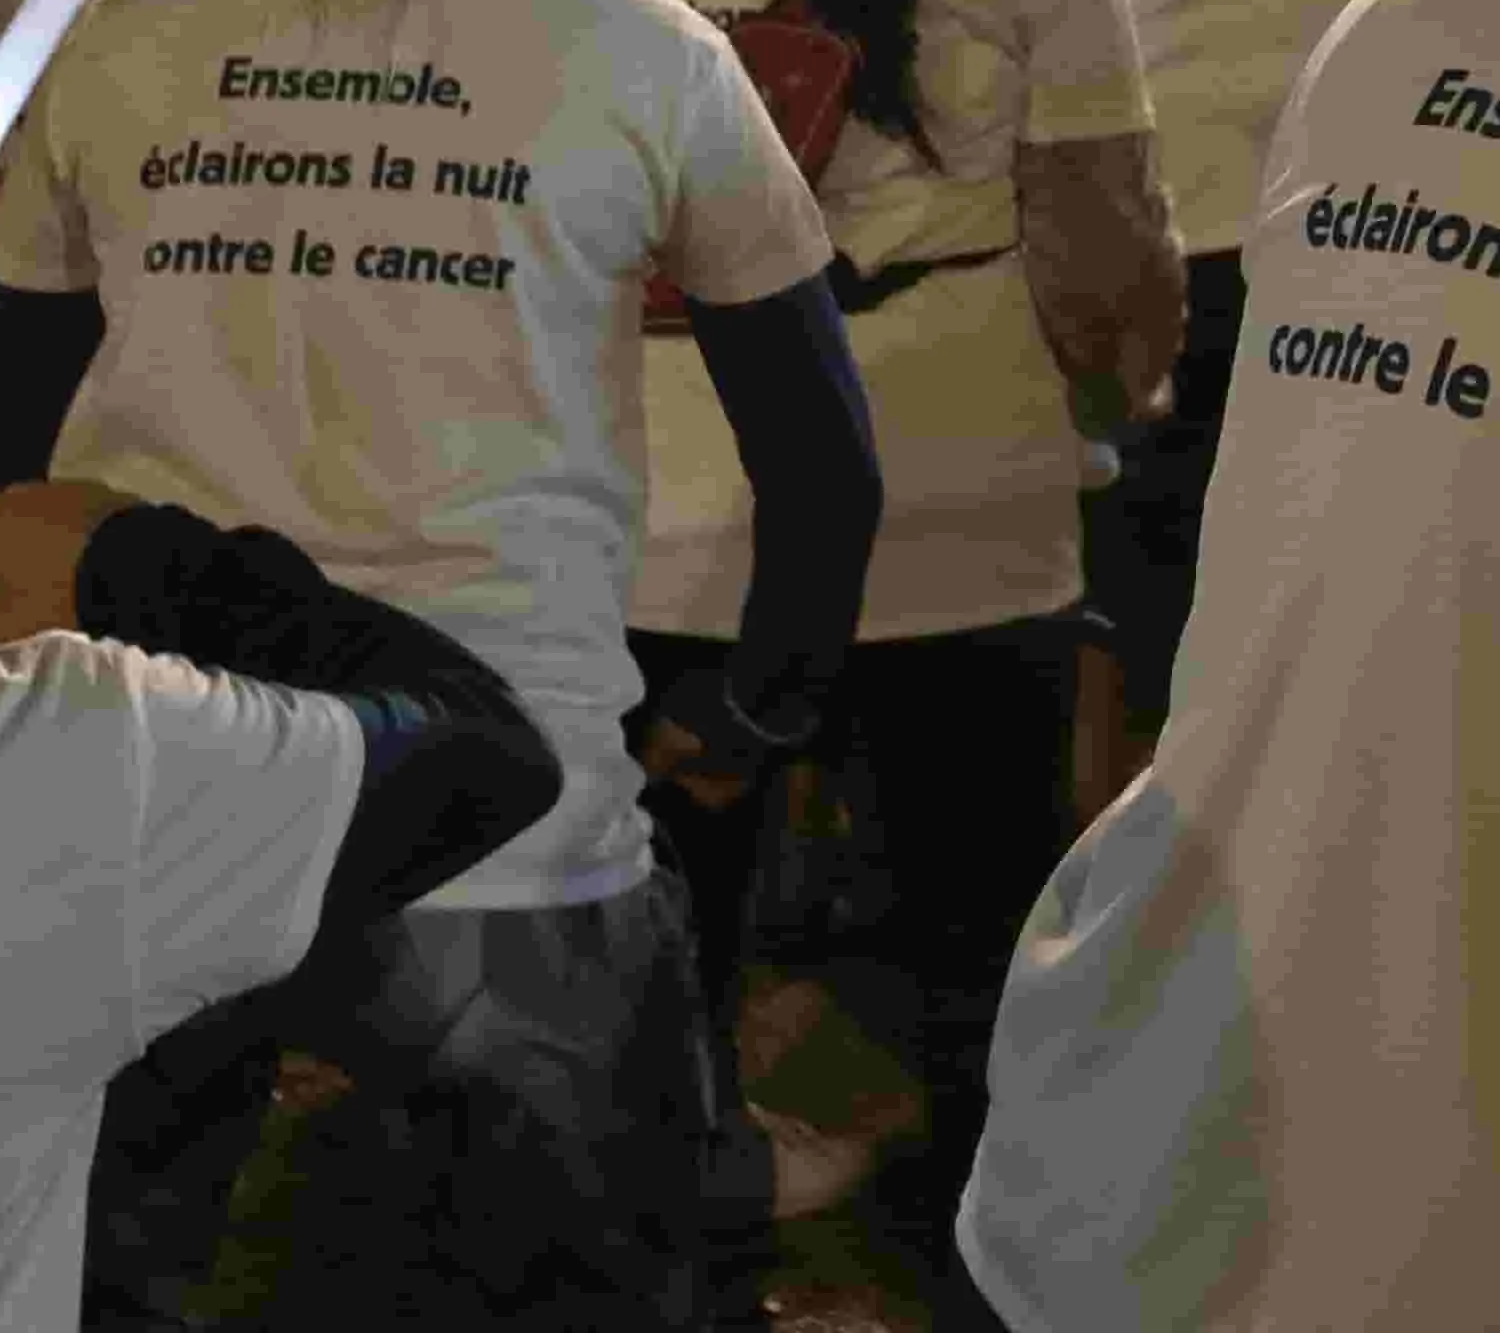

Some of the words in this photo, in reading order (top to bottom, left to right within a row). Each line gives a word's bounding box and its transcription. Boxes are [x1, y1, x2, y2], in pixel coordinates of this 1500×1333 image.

[218, 55, 473, 117] Ensemble,
[140, 140, 352, 189] éclairons
[371, 143, 414, 191] la
[432, 157, 532, 205] nuit
[290, 229, 335, 277] le
[354, 242, 516, 291] cancer
[1269, 323, 1411, 395] contre
[1424, 337, 1491, 419] le
